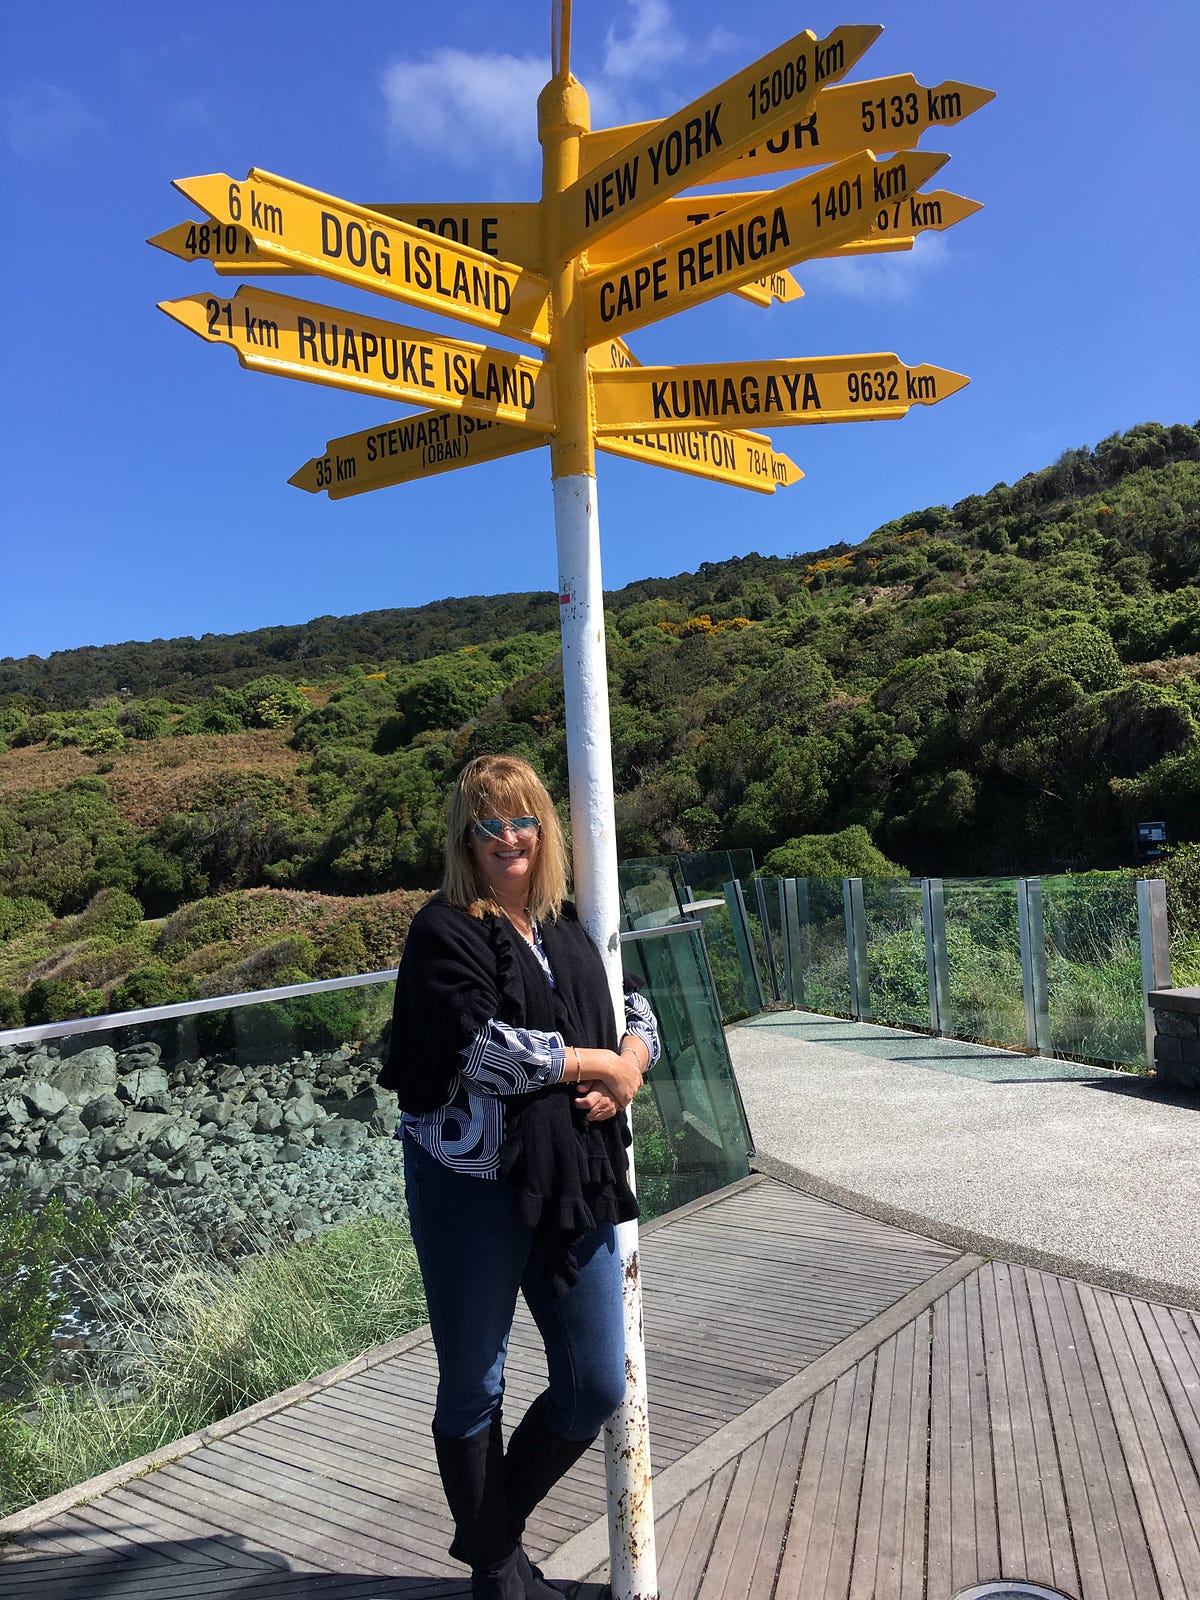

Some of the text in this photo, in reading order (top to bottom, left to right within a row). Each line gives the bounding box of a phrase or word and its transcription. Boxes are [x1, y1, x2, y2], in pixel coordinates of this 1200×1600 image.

[585, 156, 639, 229] NEW
[648, 102, 723, 186] YORK
[748, 54, 807, 120] 15008
[814, 39, 844, 83] km
[861, 89, 962, 132] 5133 km
[910, 196, 942, 227] km
[185, 224, 237, 255] 4810
[228, 183, 511, 316] 6 km DOG ISLAND
[600, 163, 906, 322] CAPE REINGA 1401 km
[770, 273, 786, 298] km
[206, 298, 536, 410] 21 km RUAPUKE ISLAND
[651, 370, 937, 419] KUMAGAYA 9632 km
[316, 458, 332, 487] 35
[336, 454, 357, 482] km
[366, 413, 450, 462] STEWART
[747, 447, 768, 477] 784
[771, 454, 788, 482] km
